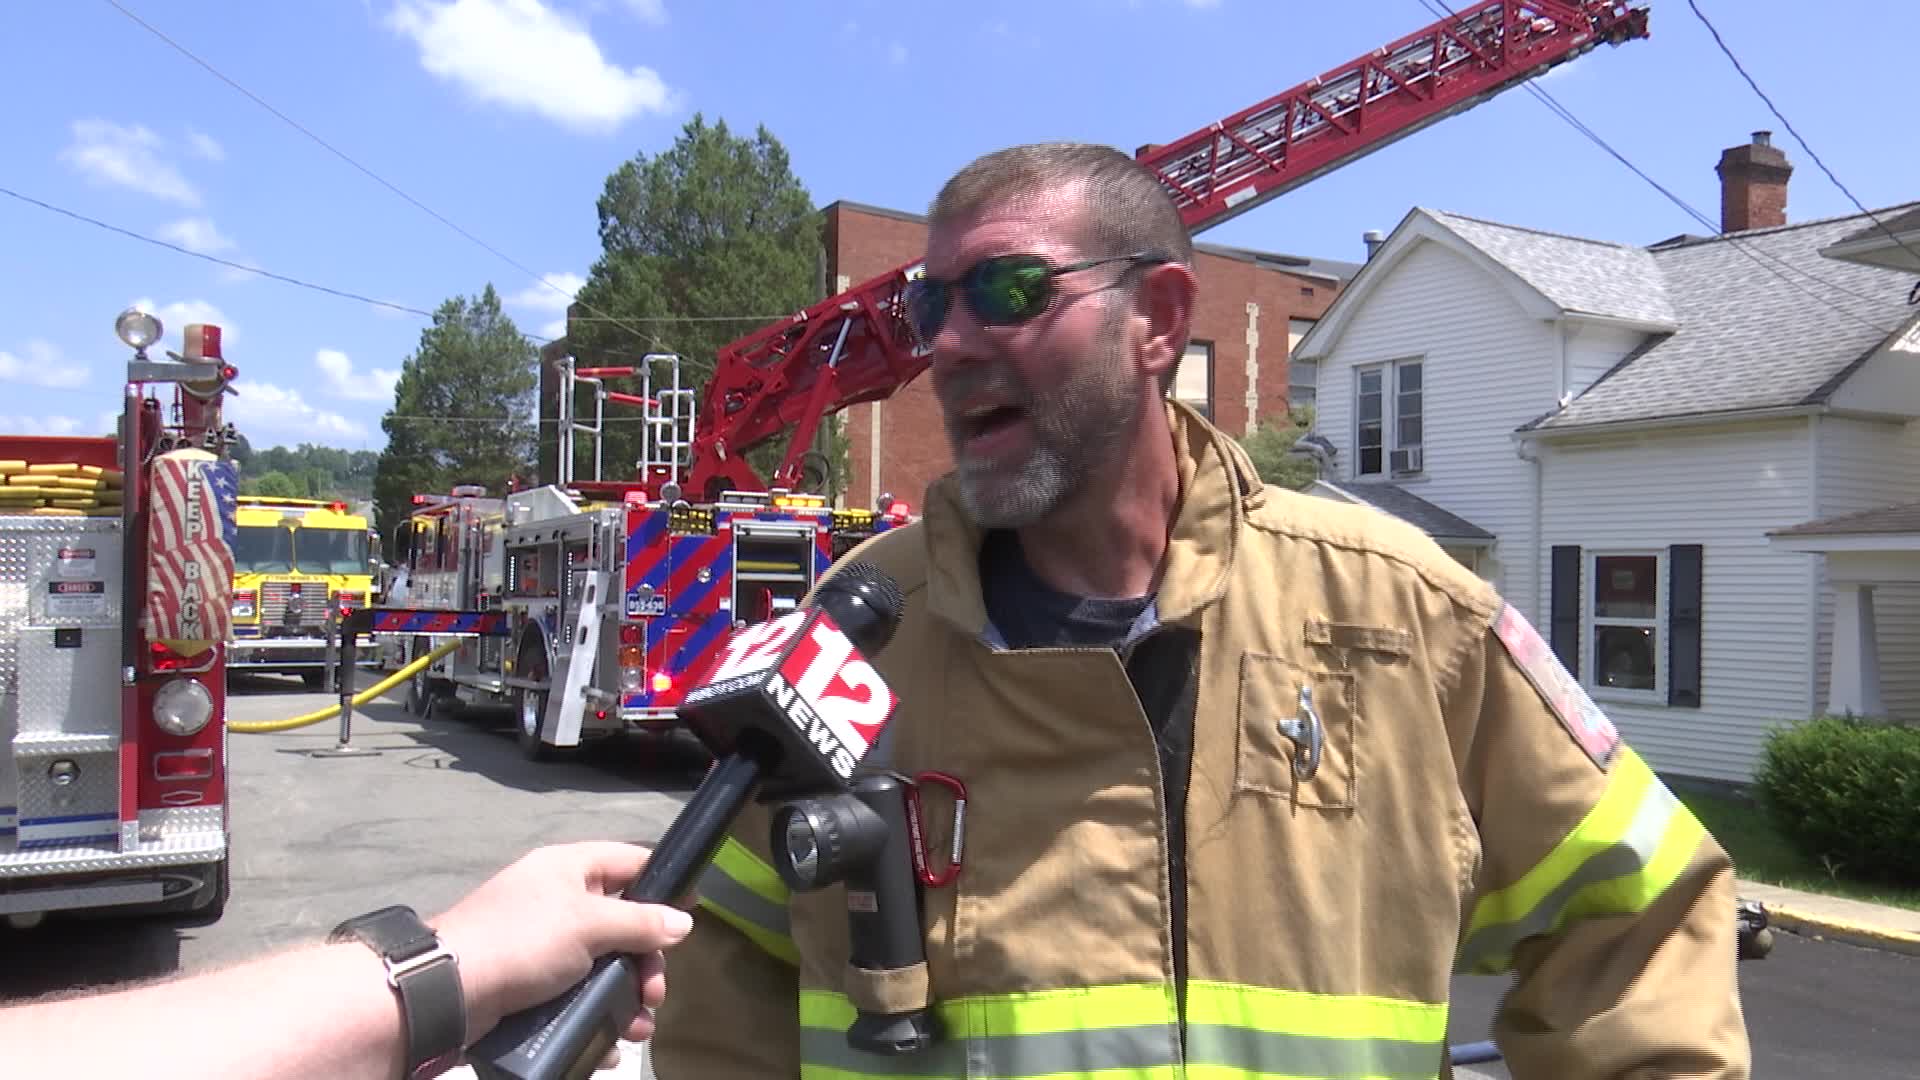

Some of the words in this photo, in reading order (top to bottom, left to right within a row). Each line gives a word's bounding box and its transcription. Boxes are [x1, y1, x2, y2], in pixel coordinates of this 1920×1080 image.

[183, 461, 202, 541] KEEP
[181, 561, 203, 640] BACK
[684, 671, 767, 704] WBOY.COM
[709, 612, 807, 685] 12
[766, 673, 856, 779] NEWS
[795, 622, 892, 761] 12
